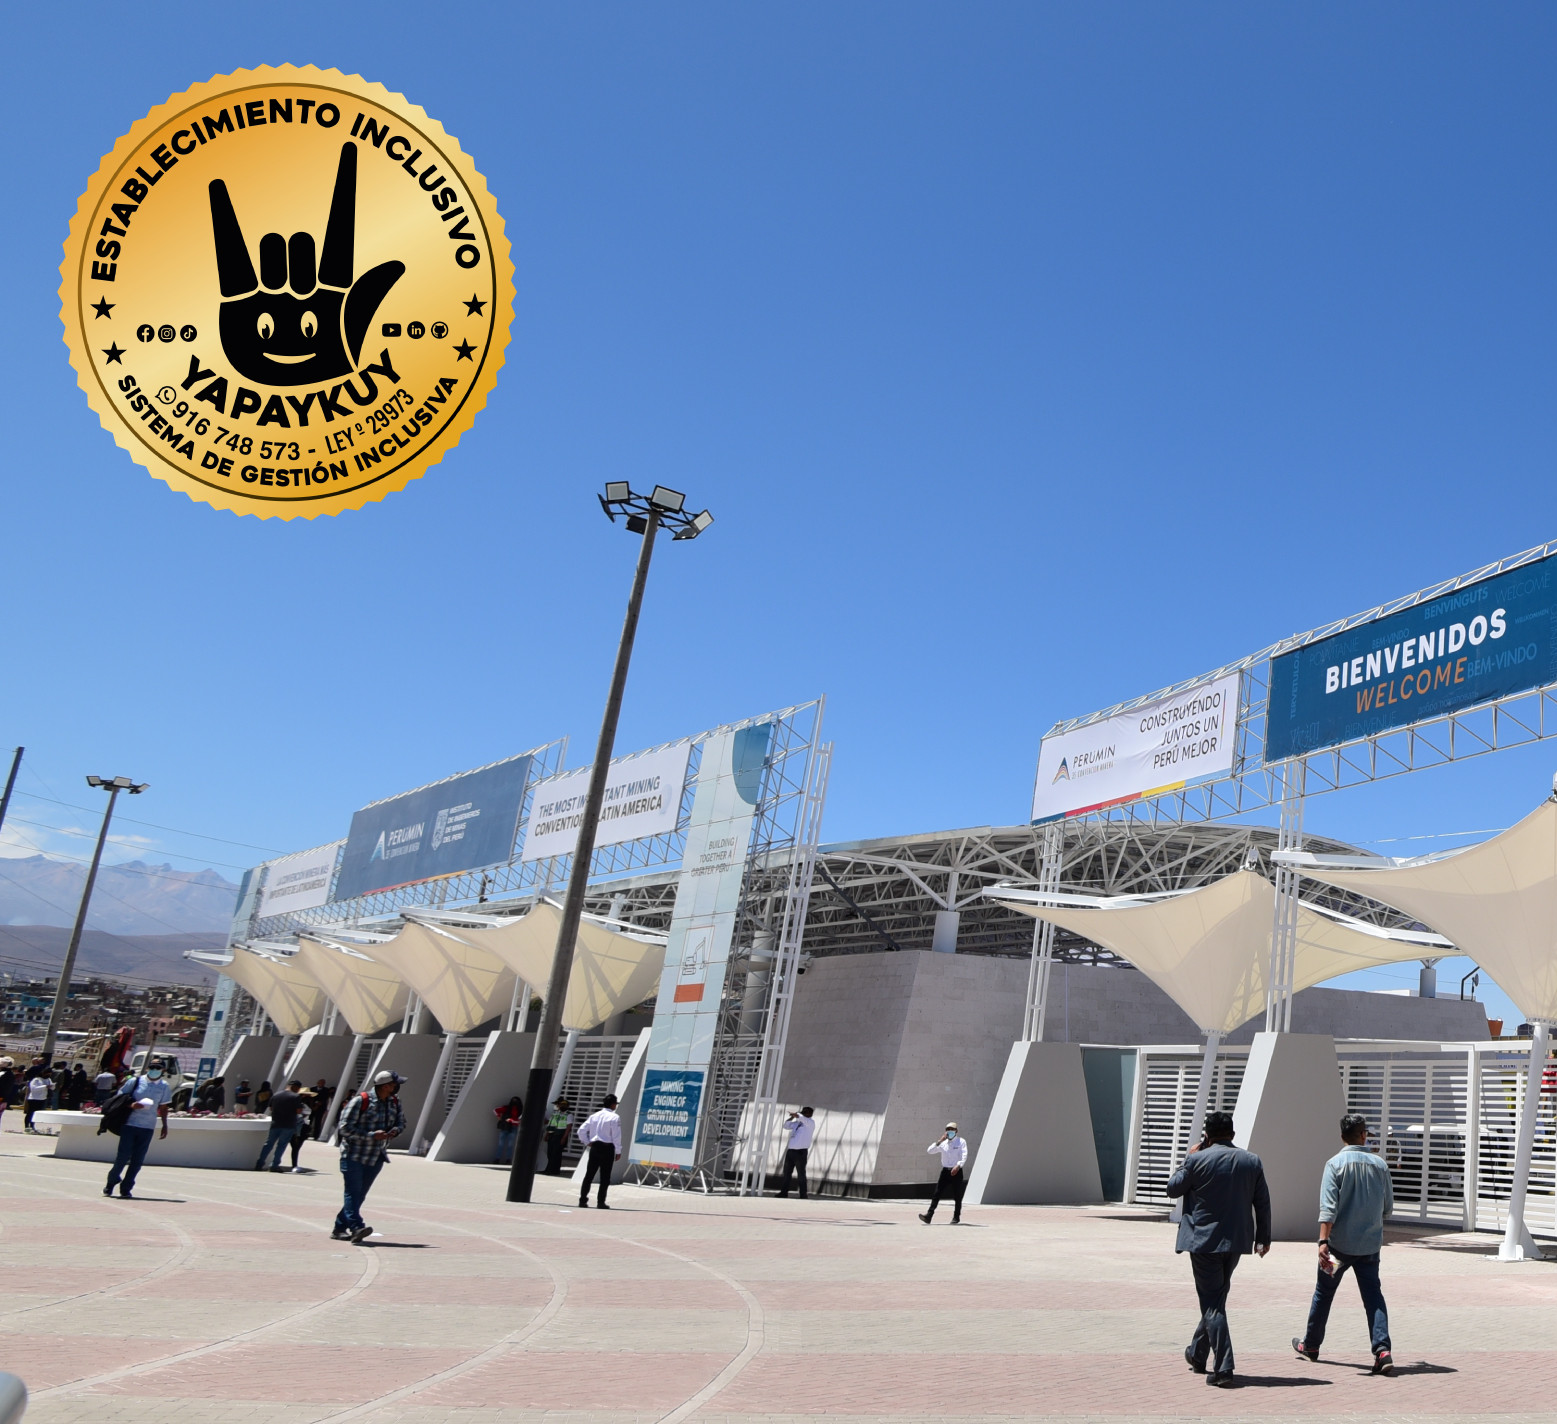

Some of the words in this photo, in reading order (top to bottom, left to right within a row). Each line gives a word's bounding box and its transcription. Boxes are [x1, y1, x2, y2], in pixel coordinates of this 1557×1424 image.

[1424, 586, 1488, 620] BENVINGUTS
[1495, 572, 1550, 603] WELCOME
[1325, 608, 1507, 694] BIENVENIDOS
[1372, 628, 1410, 649] BEM-VINDO
[1467, 643, 1537, 679] BEM-VINDO
[1356, 656, 1468, 714] WELCOME
[1140, 692, 1220, 732] CONSTRUYENDO
[1161, 721, 1200, 746] JUNTOS
[1204, 714, 1218, 732] UN
[1154, 744, 1179, 769] PERÚ
[1182, 737, 1217, 761] MEJOR
[538, 805, 552, 818] THE
[554, 797, 576, 815] MOST
[626, 776, 660, 796] MINING
[621, 794, 662, 816] AMERICA
[700, 851, 728, 863] TOGETHER
[728, 850, 732, 859] A
[708, 837, 734, 850] BUILDING
[654, 1095, 678, 1107] ENGINE
[678, 1096, 686, 1107] OF
[660, 1081, 684, 1092] MINING
[642, 1123, 688, 1138] DEVELOPMENT
[646, 1108, 674, 1121] GROWTH
[674, 1111, 688, 1122] AND
